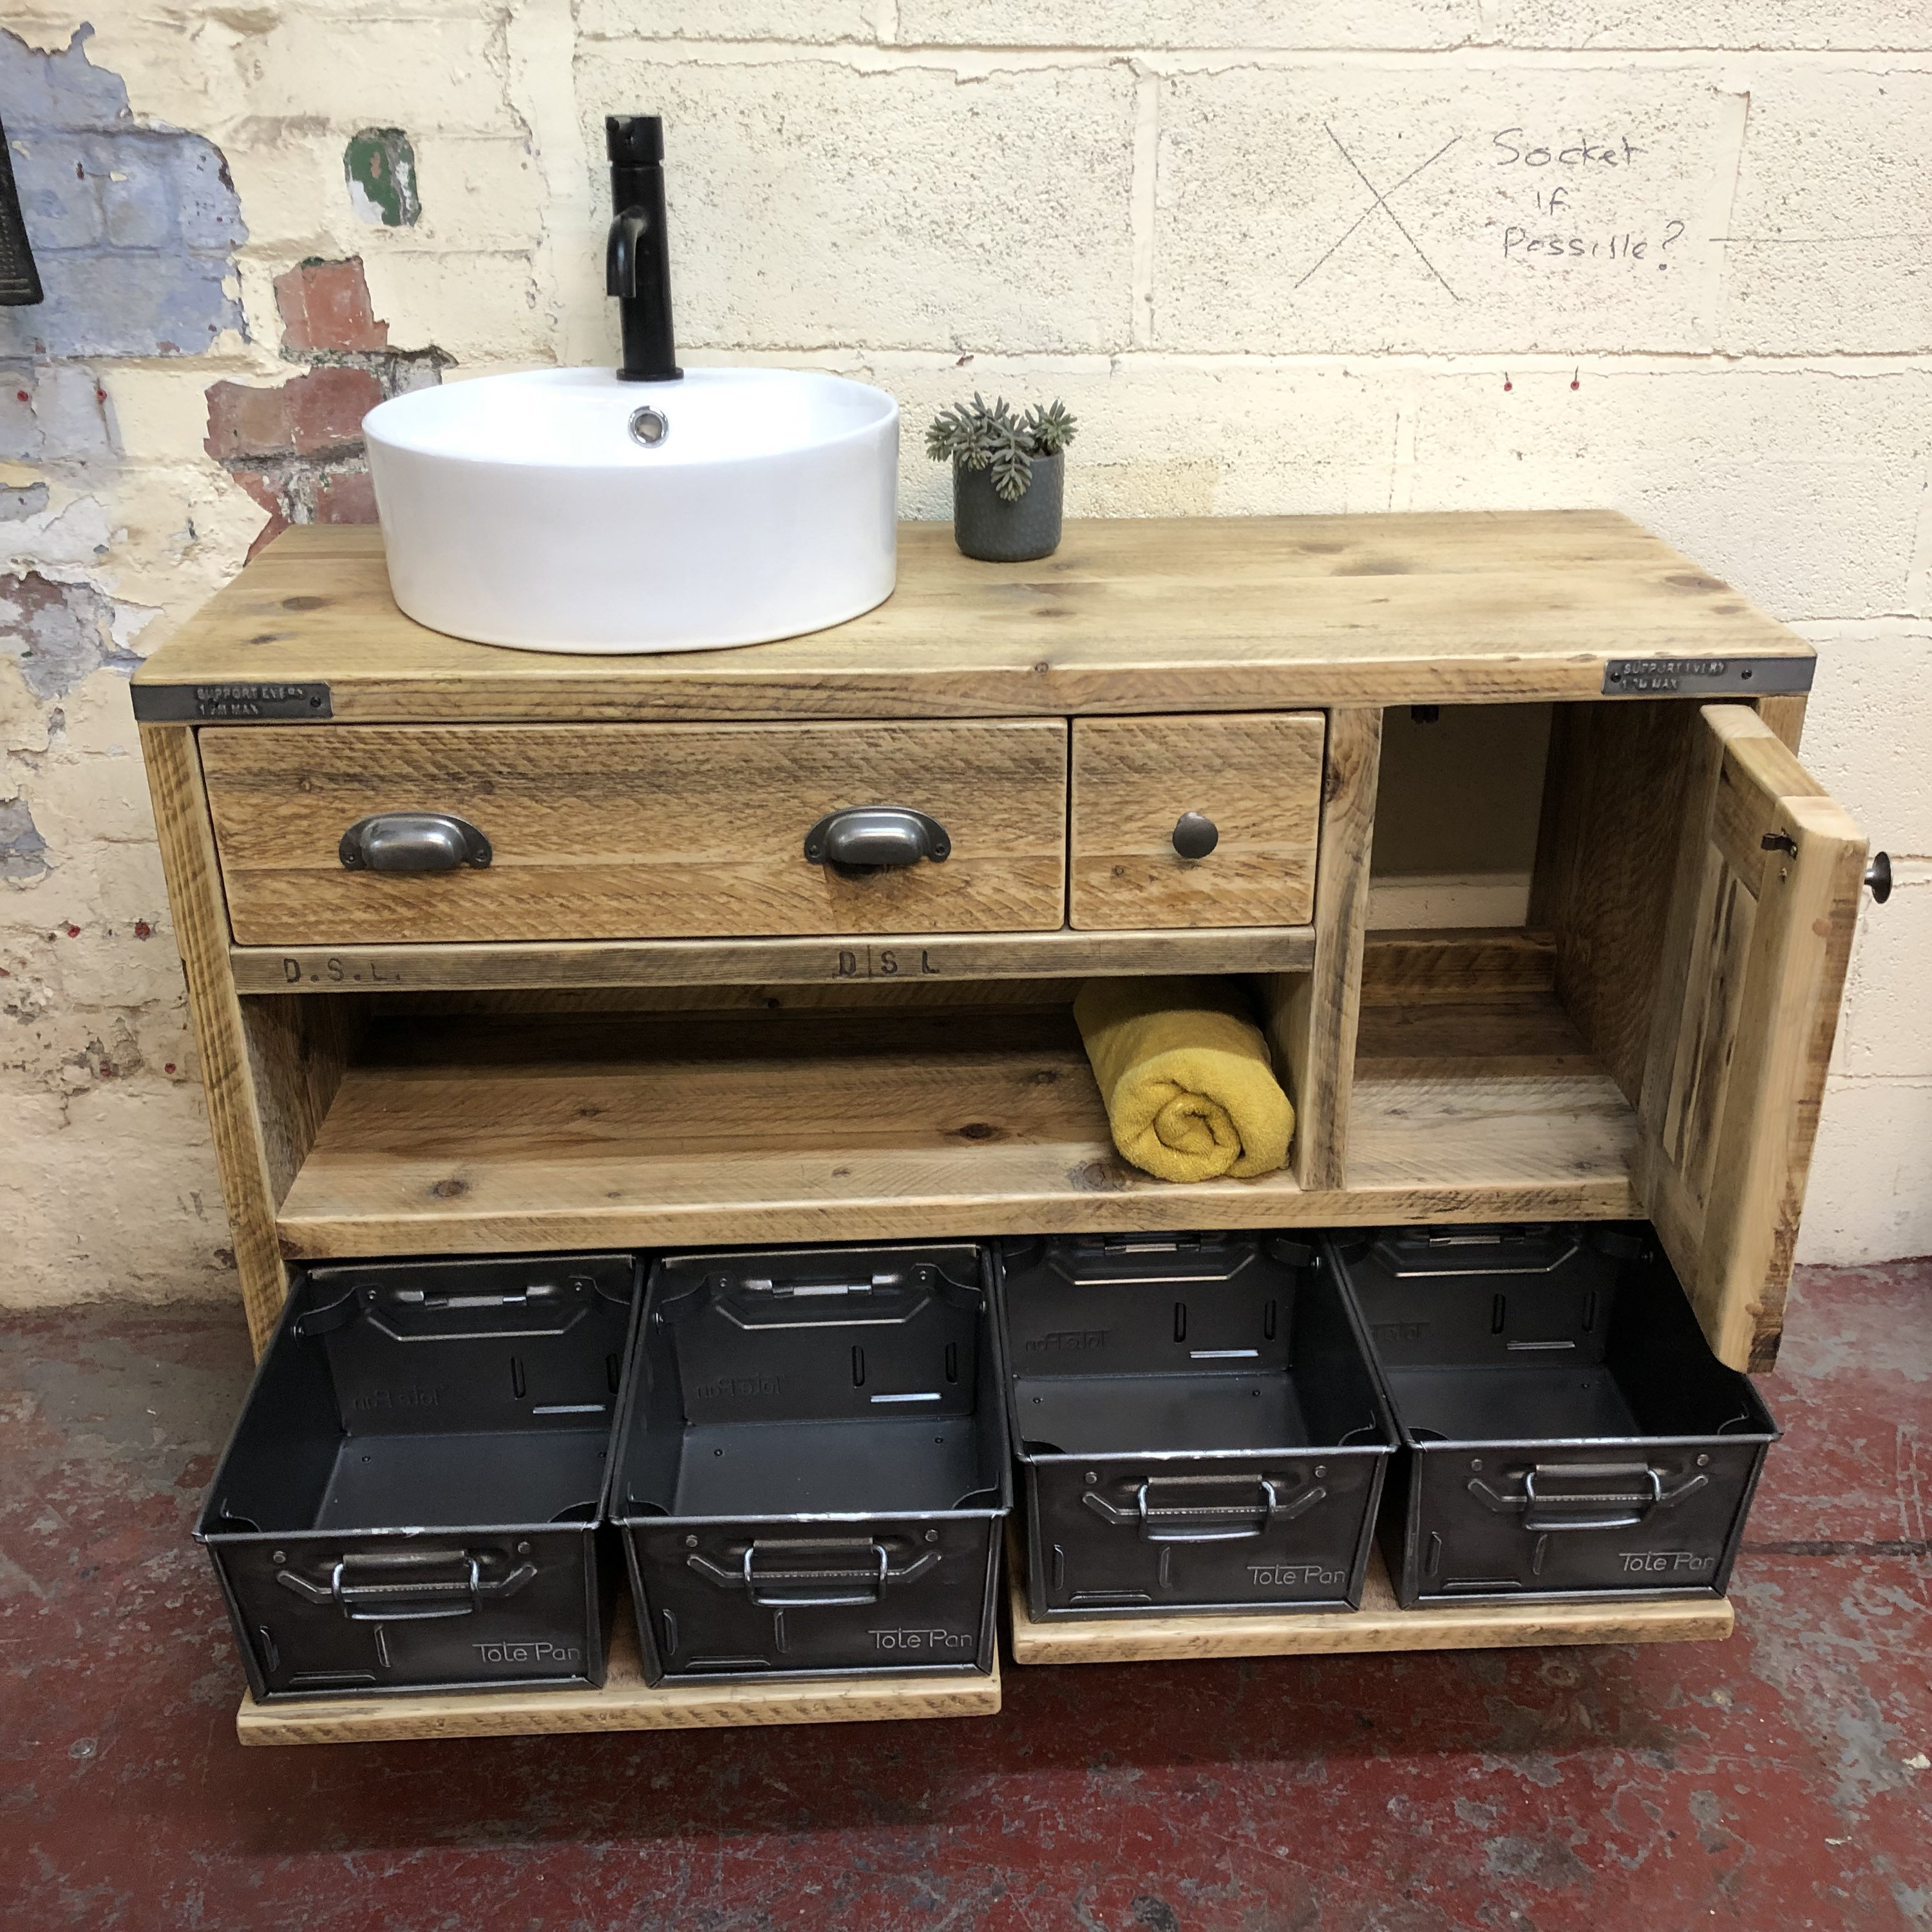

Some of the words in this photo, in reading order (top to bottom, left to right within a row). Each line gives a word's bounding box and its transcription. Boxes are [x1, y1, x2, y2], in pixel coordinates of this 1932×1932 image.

[1492, 128, 1649, 166] Socket
[1618, 1551, 1667, 1571] Tote
[1247, 1564, 1296, 1585] Tote
[1303, 1565, 1345, 1584] Pan
[867, 1627, 922, 1649] Tote
[929, 1629, 972, 1648] Pan
[472, 1642, 528, 1662] Tote
[535, 1642, 581, 1662] Pan
